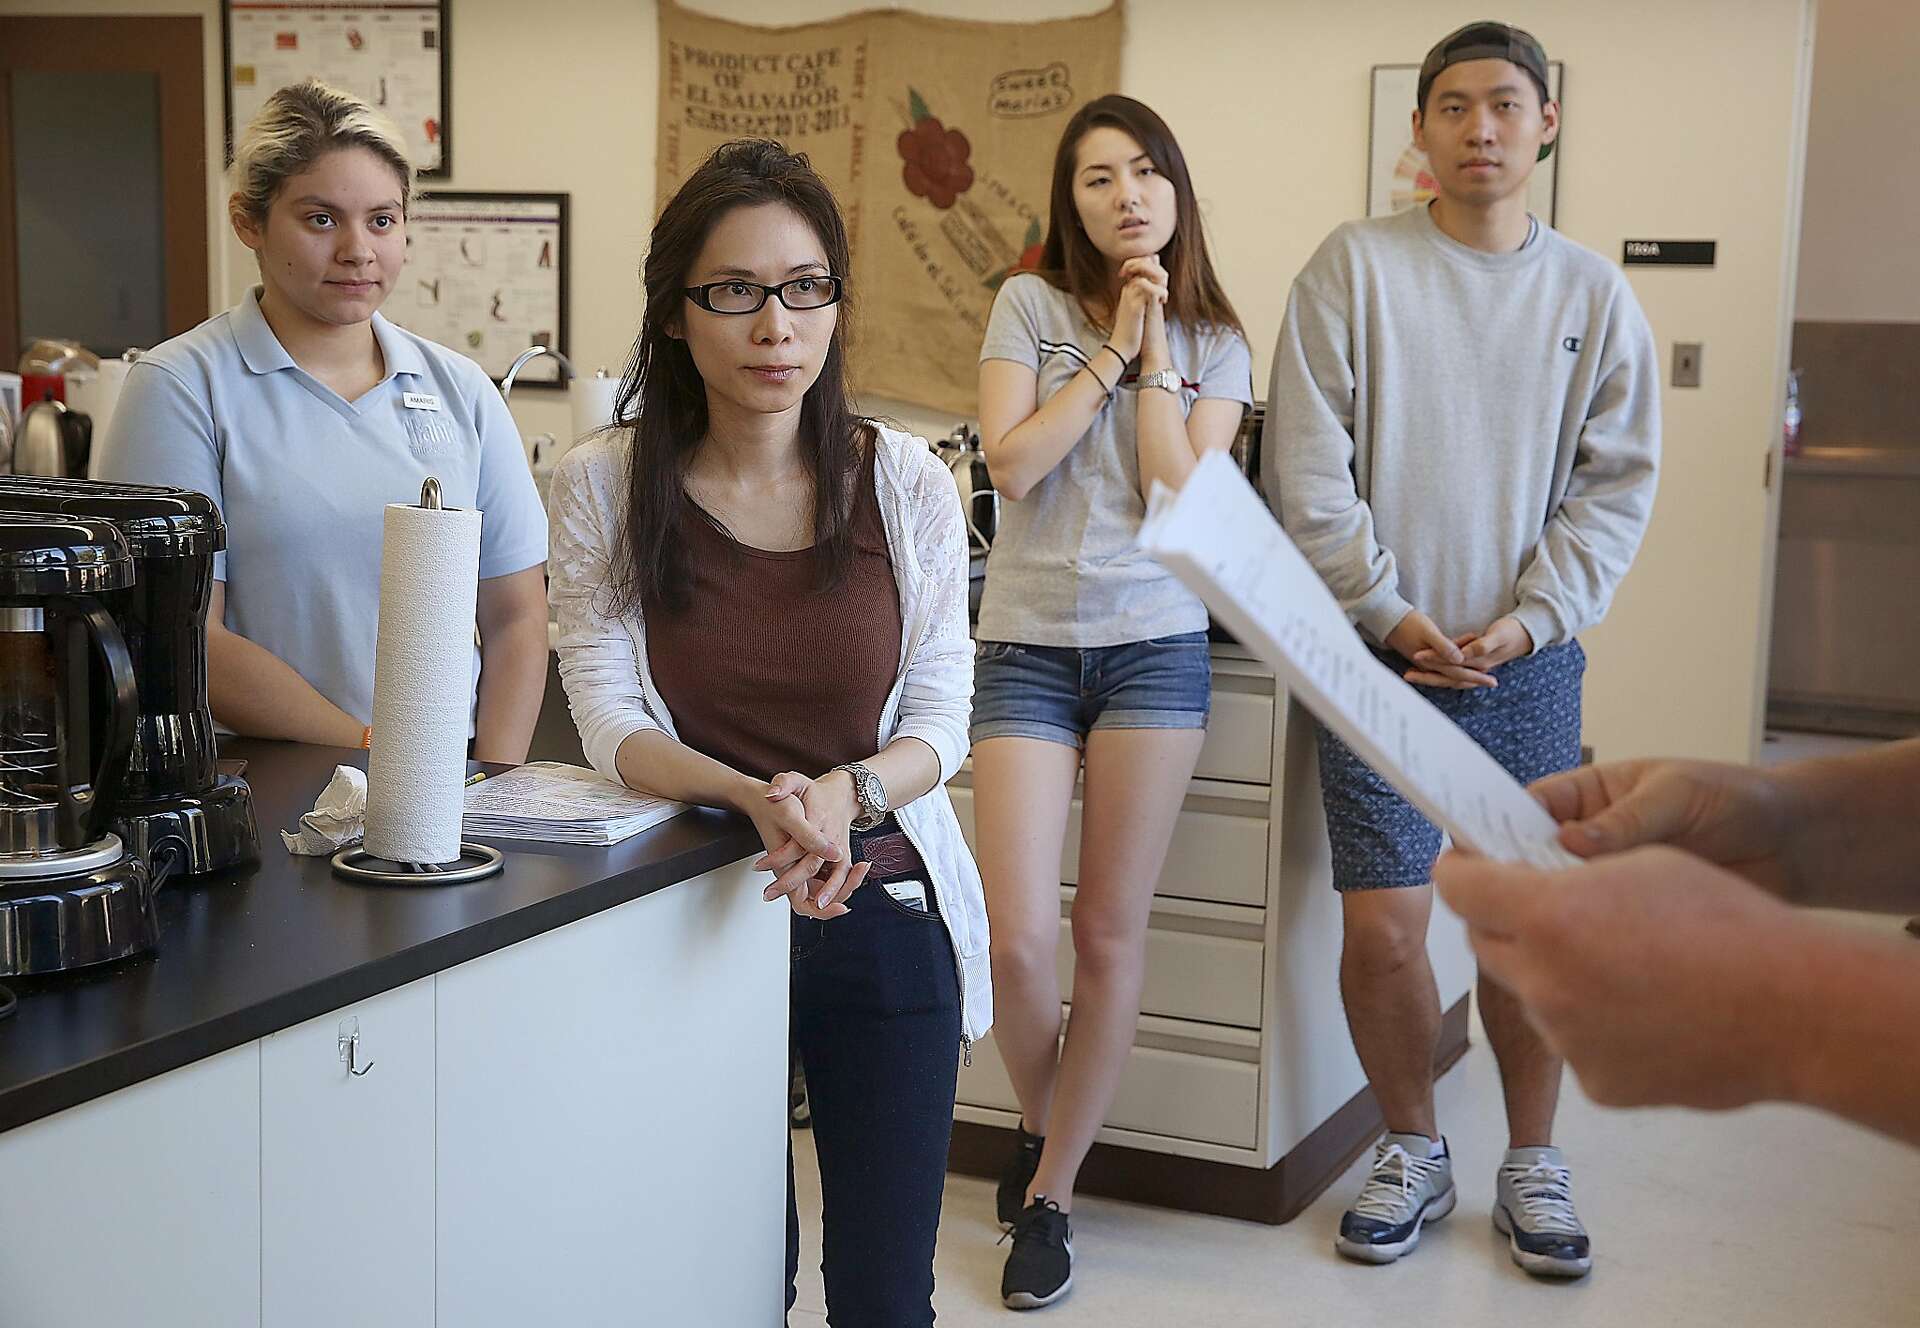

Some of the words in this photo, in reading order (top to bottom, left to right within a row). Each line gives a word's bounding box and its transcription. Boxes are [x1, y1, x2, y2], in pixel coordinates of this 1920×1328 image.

[683, 45, 780, 74] PRODUCT
[785, 47, 842, 73] CAFE
[713, 70, 744, 89] OF
[795, 68, 827, 90] DE
[686, 83, 713, 104] EL
[718, 86, 840, 110] SALVADOR
